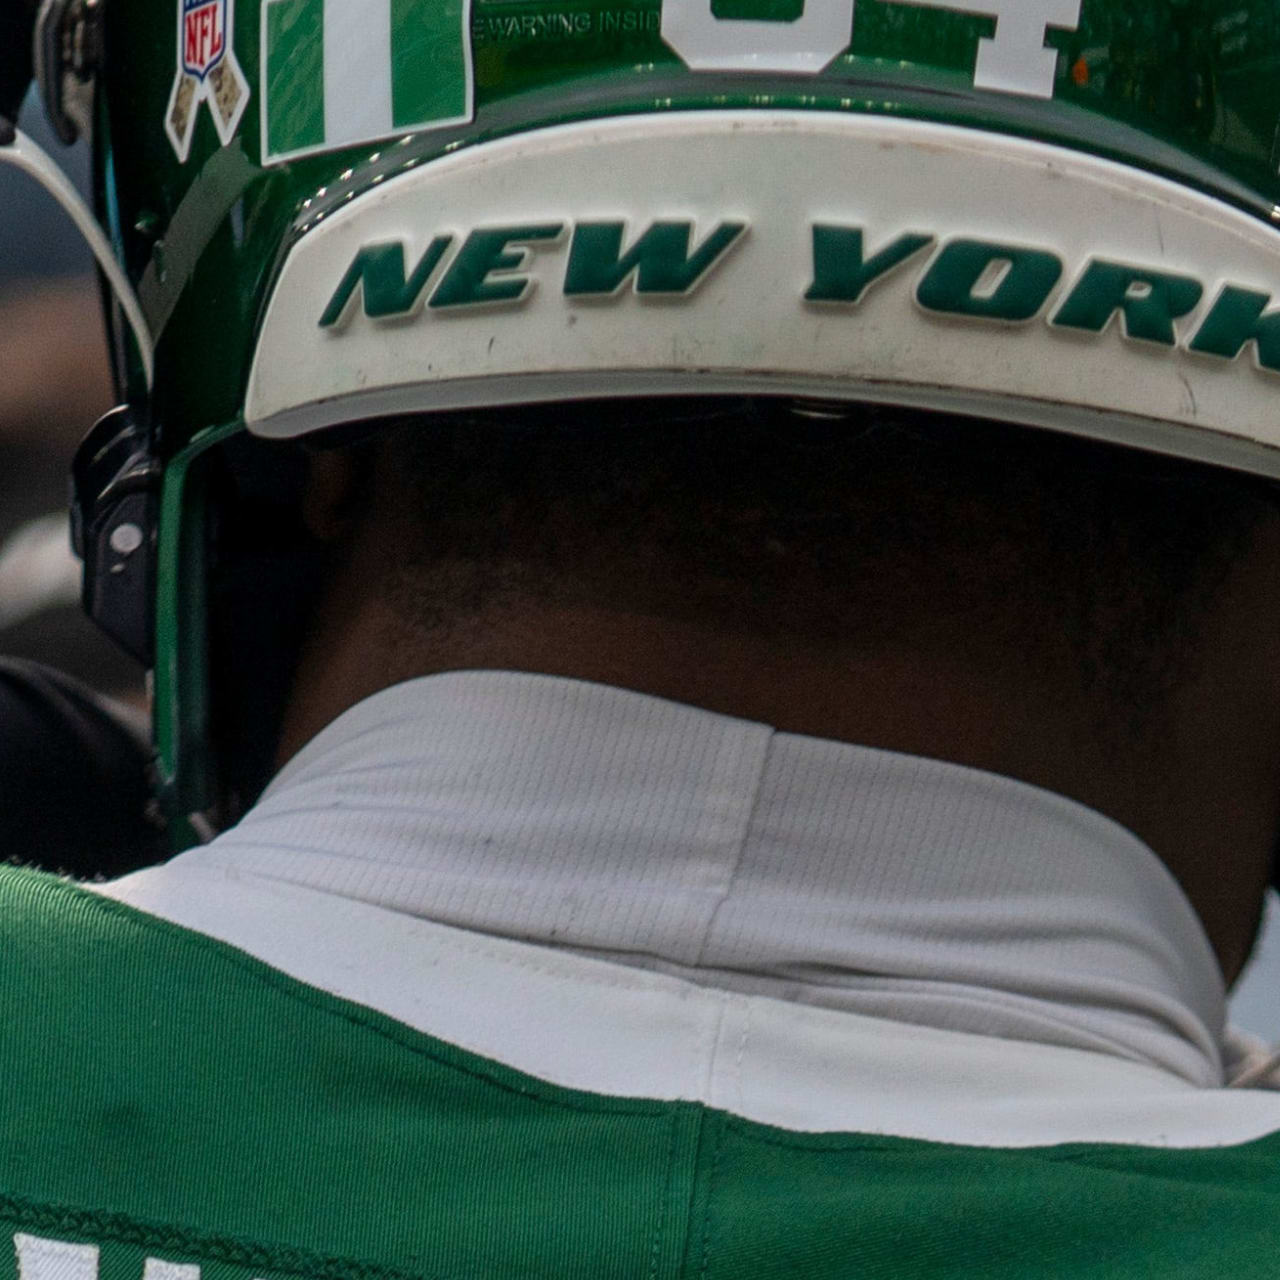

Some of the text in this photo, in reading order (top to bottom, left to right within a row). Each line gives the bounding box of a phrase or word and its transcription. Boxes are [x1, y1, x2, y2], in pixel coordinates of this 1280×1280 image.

[185, 2, 223, 67] NFL
[489, 11, 591, 37] WARNING
[600, 9, 662, 33] INSID
[318, 220, 748, 330] NEW
